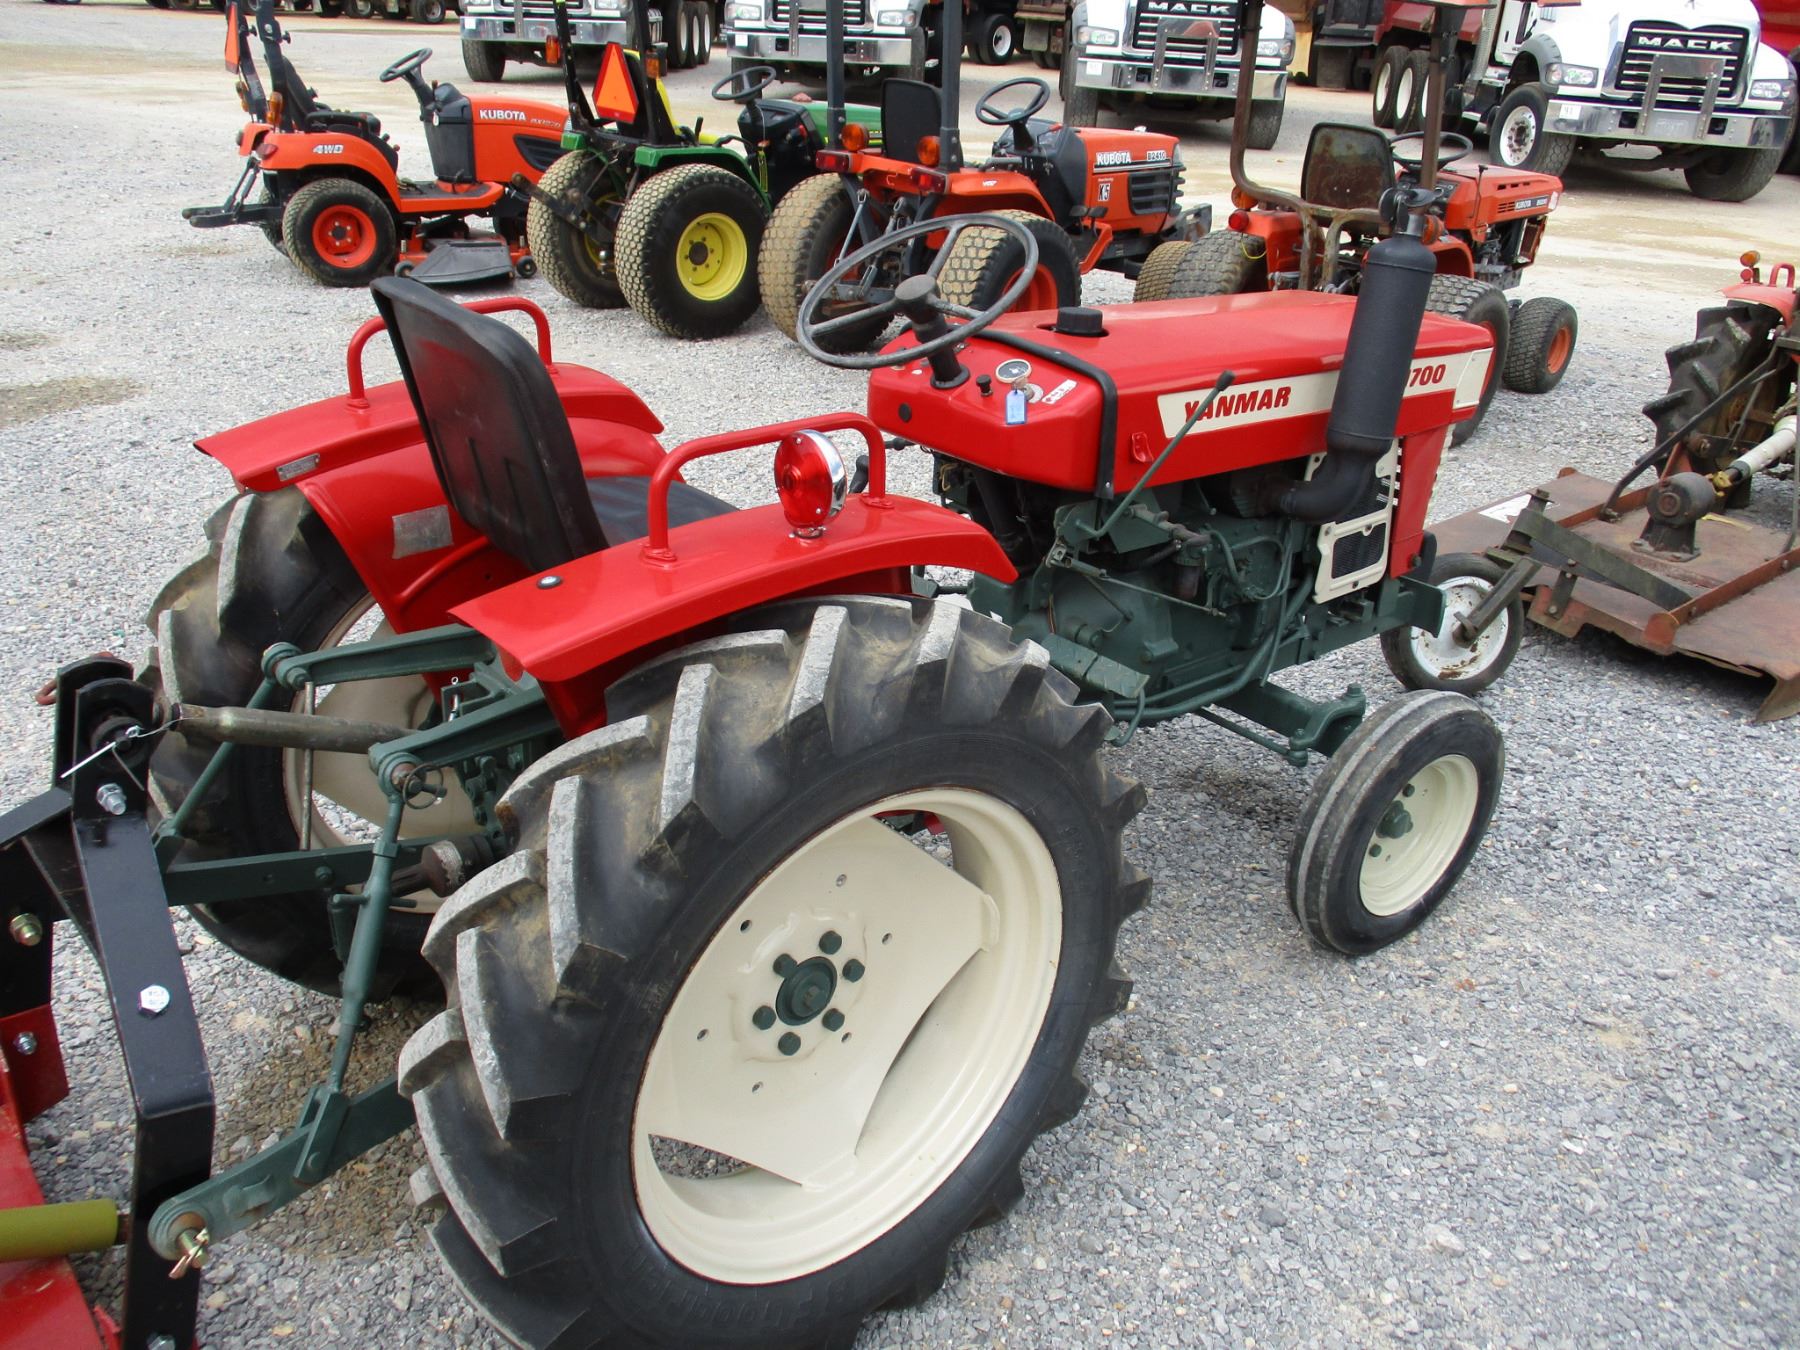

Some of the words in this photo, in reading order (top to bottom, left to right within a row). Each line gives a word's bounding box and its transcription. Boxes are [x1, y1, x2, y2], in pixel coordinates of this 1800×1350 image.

[1148, 2, 1230, 14] MACK
[1638, 36, 1733, 51] MACK
[480, 110, 526, 120] KUBOTA
[313, 144, 344, 154] 4WD
[1096, 152, 1131, 165] KUBOTA
[1184, 386, 1291, 423] YANMAR
[1407, 364, 1446, 387] 700
